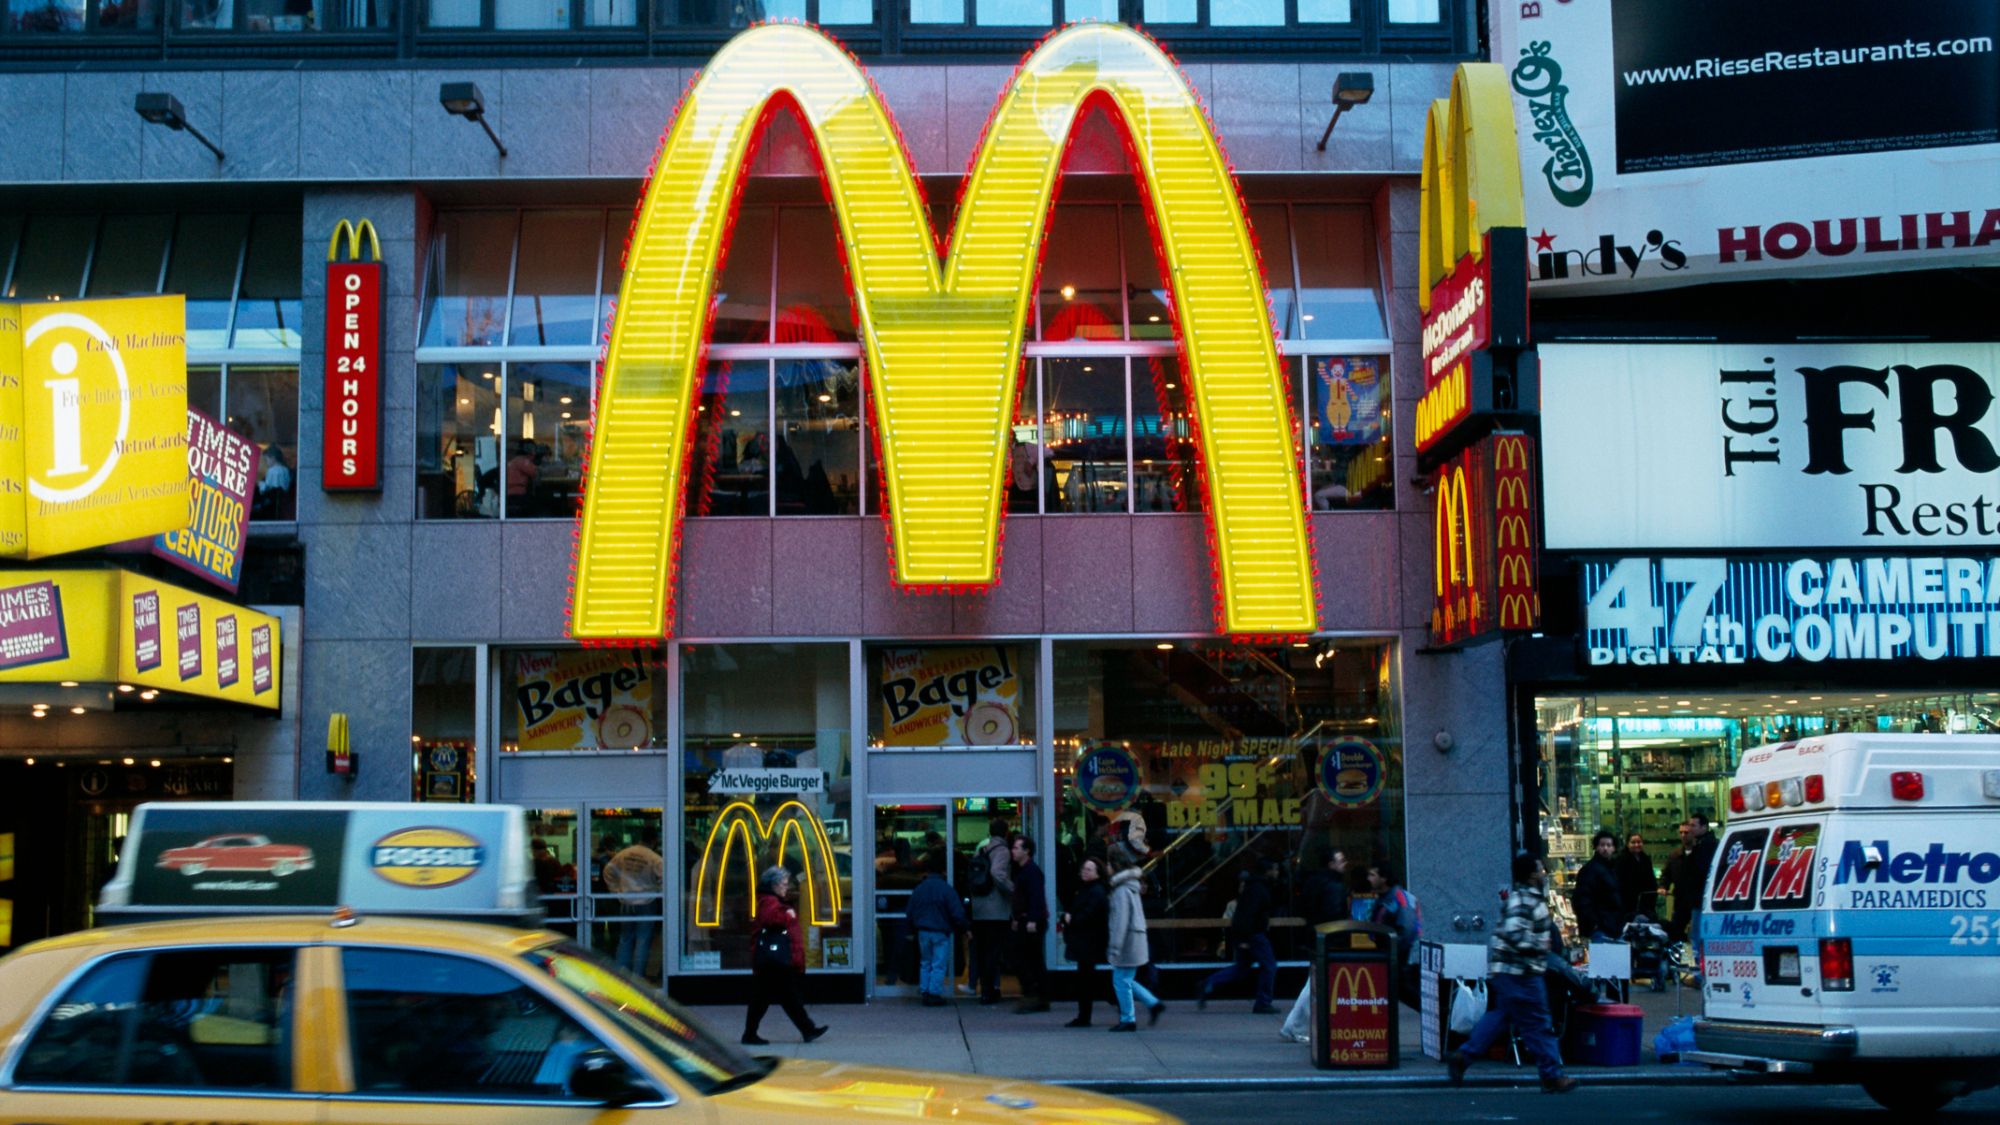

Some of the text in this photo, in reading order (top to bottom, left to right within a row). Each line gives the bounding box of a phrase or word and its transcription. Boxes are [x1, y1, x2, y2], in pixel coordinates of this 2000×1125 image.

[1528, 86, 1594, 208] Charley
[1718, 208, 2000, 263] HOULIHA
[344, 274, 362, 349] OPEN
[1422, 276, 1484, 360] McDonald's
[86, 332, 186, 352] Cash Machines
[337, 356, 366, 373] 24
[62, 389, 90, 408] Free
[149, 383, 186, 399] Access
[342, 379, 359, 476] HOURS
[1720, 356, 1780, 476] T.G.I.
[1794, 364, 2000, 475] FR
[113, 431, 188, 457] MetroCards
[187, 409, 252, 474] TIMES
[188, 446, 248, 498] QUARE
[39, 487, 123, 516] International
[188, 476, 244, 551] SITORS
[1858, 483, 2000, 536] Rest
[164, 529, 235, 579] CENTER
[0, 586, 49, 610] IMES
[134, 595, 157, 614] TIMES
[1587, 557, 1744, 646] 47th
[0, 602, 52, 627] QUARE
[178, 607, 198, 625] TIMES
[216, 618, 235, 636] TIMES
[0, 635, 55, 654] PROVEMENT
[1590, 646, 1745, 665] DIGITAL
[883, 649, 924, 673] New!
[517, 648, 648, 728] Bagel
[882, 646, 1014, 725] Bagel
[526, 712, 584, 741] SANDWICHES
[892, 709, 950, 737] SANDWICHES
[1161, 737, 1301, 760] Late Night SPECIAL
[1748, 744, 1825, 764] KEEP BACK
[721, 773, 779, 791] McVeggie
[780, 773, 820, 791] Burger
[1166, 797, 1302, 828] BIG MAC
[373, 845, 481, 866] FOSSIL
[1851, 889, 1987, 909] PARAMEDICS
[1720, 913, 1795, 936] Metro Care
[1707, 940, 1754, 954] PARAMEDICS
[1706, 960, 1724, 977] 251
[1733, 960, 1757, 978] 8888
[1337, 997, 1388, 1006] McDonald's
[1331, 1028, 1387, 1041] BROADWAY
[1331, 1049, 1388, 1061] 46th Street
